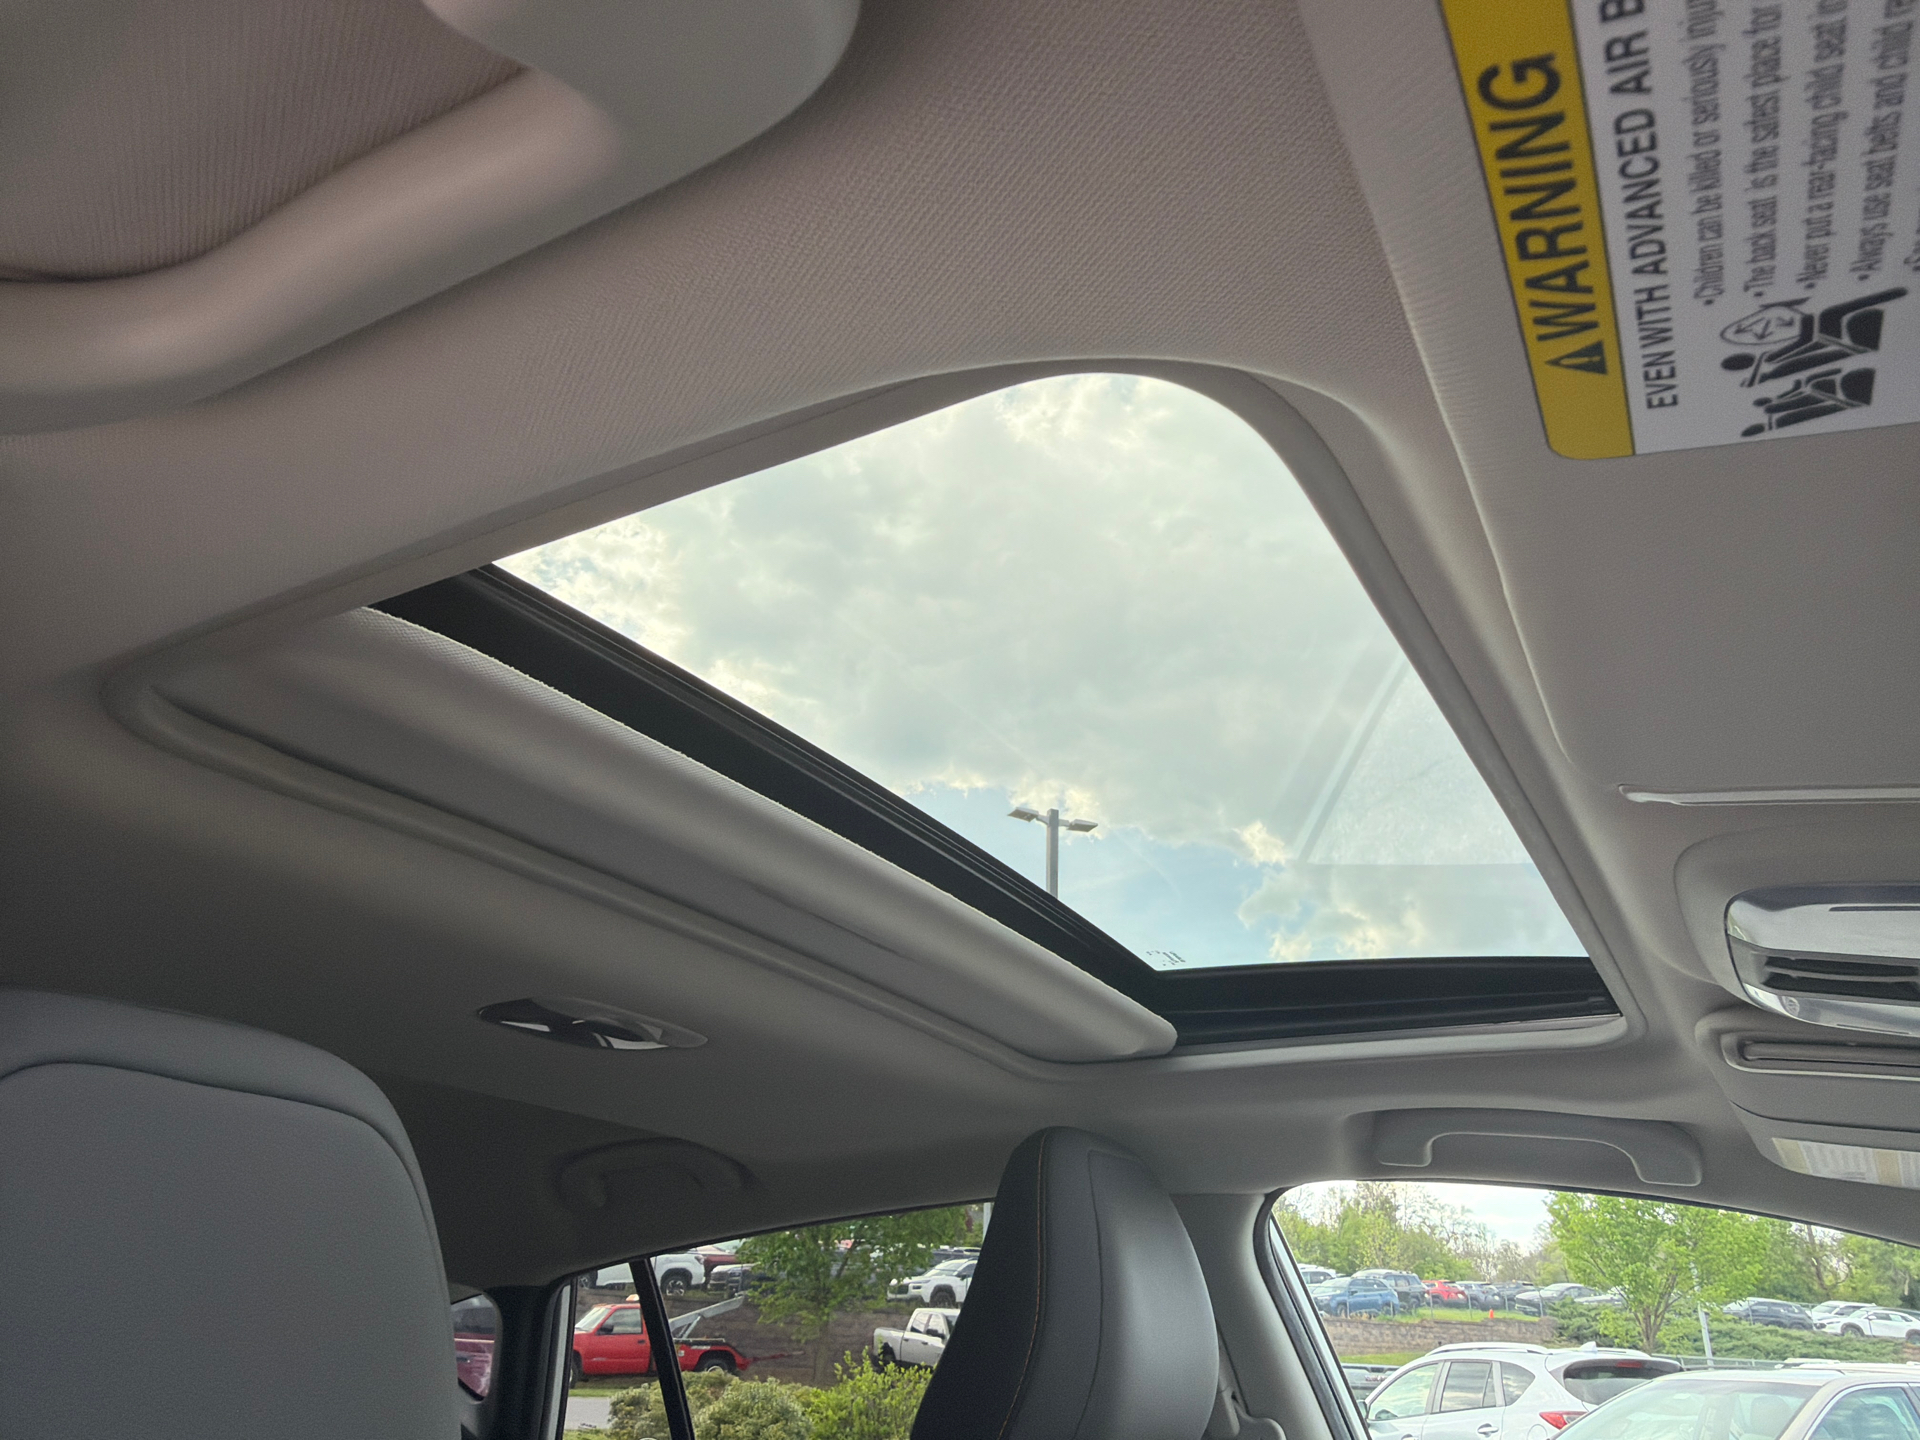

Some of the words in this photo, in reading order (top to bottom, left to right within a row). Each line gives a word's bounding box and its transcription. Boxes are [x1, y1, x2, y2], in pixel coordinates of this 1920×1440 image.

[1741, 4, 1783, 36] for
[1810, 16, 1848, 62] seat
[1604, 30, 1652, 94] AIR
[1741, 36, 1790, 87] place
[1869, 20, 1914, 70] child
[1680, 44, 1726, 125] seriously
[1803, 62, 1845, 110] child
[1868, 72, 1909, 110] and
[1742, 89, 1780, 143] safest
[1860, 110, 1903, 155] belts
[1692, 129, 1721, 148] or
[1742, 147, 1779, 173] the
[1801, 111, 1848, 200] rear-facing
[1613, 108, 1668, 277] ADVANCED
[1686, 150, 1722, 193] killed
[1743, 173, 1778, 192] is
[1861, 154, 1896, 191] seat
[1476, 52, 1601, 342] WARNING
[1690, 193, 1723, 215] be
[1747, 195, 1778, 228] seat
[1807, 201, 1834, 213] a
[1861, 192, 1891, 221] use
[1697, 214, 1723, 241] can
[1743, 229, 1777, 263] back
[1801, 213, 1837, 240] put
[1848, 222, 1894, 273] Always
[1692, 243, 1724, 298] Children
[1743, 265, 1776, 292] The
[1795, 243, 1830, 283] Never
[1634, 286, 1674, 347] WITH
[1642, 350, 1679, 410] EVEN
